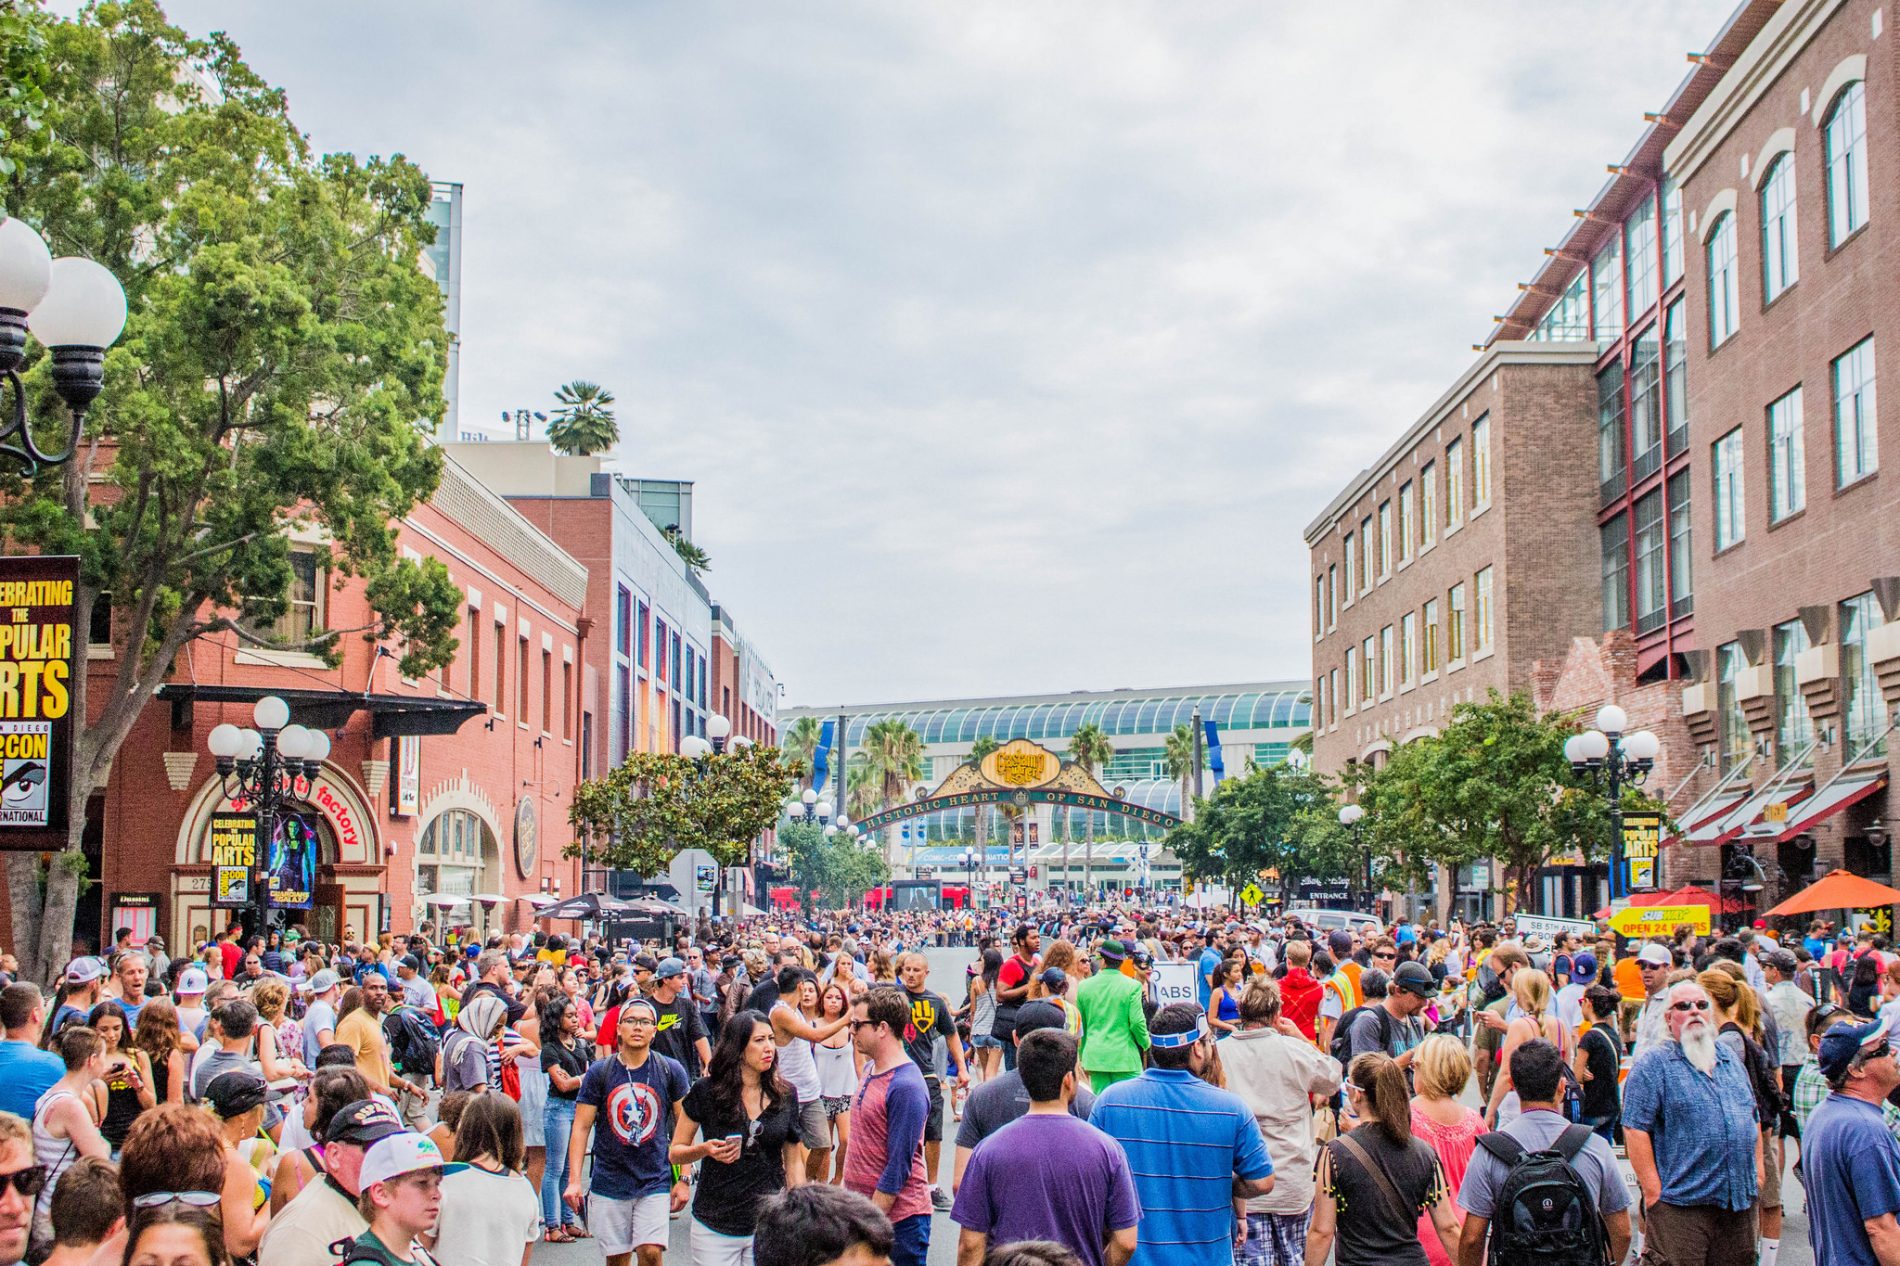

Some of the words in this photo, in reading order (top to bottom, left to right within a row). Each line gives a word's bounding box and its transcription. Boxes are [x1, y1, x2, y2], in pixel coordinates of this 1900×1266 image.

[12, 608, 29, 622] THE
[316, 785, 359, 846] factory
[866, 800, 940, 829] HISTORIC
[949, 792, 999, 806] HEART
[1046, 792, 1066, 802] OF
[1077, 796, 1109, 809] SAN
[1121, 804, 1174, 827] DIEGO
[213, 819, 256, 829] CELEBRATING
[212, 833, 256, 847] POPULAR
[1623, 840, 1659, 858] ARTS
[212, 846, 255, 867] ARTS
[1309, 892, 1348, 900] ENTRANCE
[1641, 909, 1690, 921] SUBWAY
[1530, 921, 1542, 930] SB
[1545, 923, 1560, 931] 5TH
[1561, 925, 1578, 934] AVE
[1622, 923, 1651, 934] OPEN
[1654, 923, 1668, 933] 24
[661, 1013, 679, 1023] NIKE
